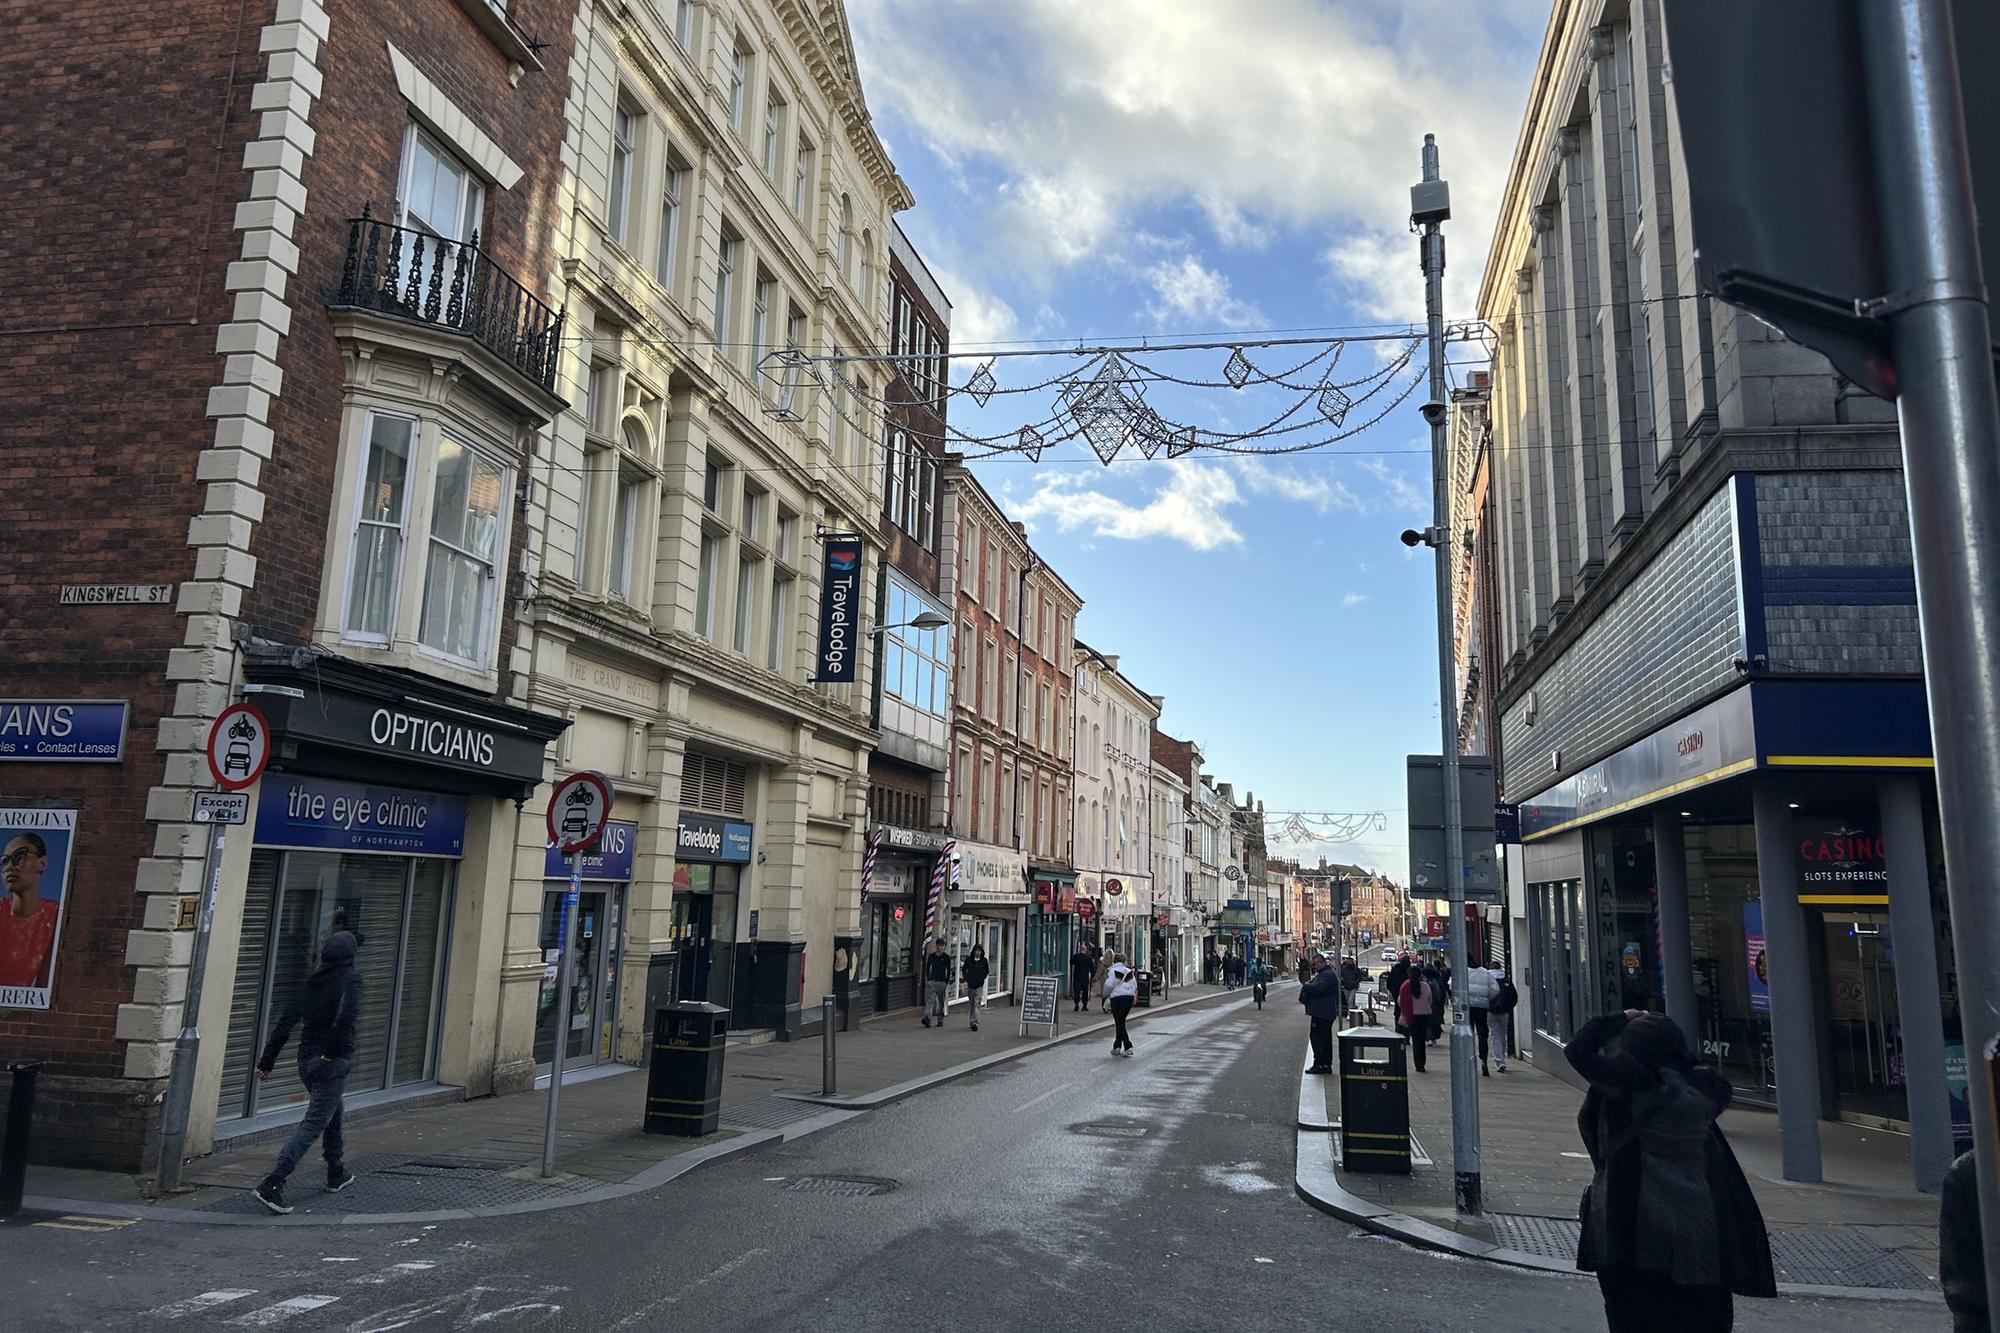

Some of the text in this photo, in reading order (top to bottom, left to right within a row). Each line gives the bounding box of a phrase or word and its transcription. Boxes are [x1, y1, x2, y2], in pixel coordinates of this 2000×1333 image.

[63, 586, 168, 602] KINGSWELL ST
[825, 575, 853, 673] Travelodge
[569, 661, 651, 701] THE GRAND HOTEL
[0, 704, 74, 737] ANS
[371, 708, 494, 765] OPTICIANS
[0, 741, 117, 754] les Contact Lenses
[201, 797, 243, 809] Except
[288, 785, 428, 831] the eye clinic
[0, 811, 71, 827] AROLINA
[351, 836, 362, 844] OF
[366, 836, 425, 848] NORTHAMPTON
[679, 824, 720, 854] Travelodge
[1804, 870, 1887, 881] SLOTS EXPERIENC
[1703, 1039, 1731, 1057] 24/7
[1361, 1067, 1385, 1076] Litter
